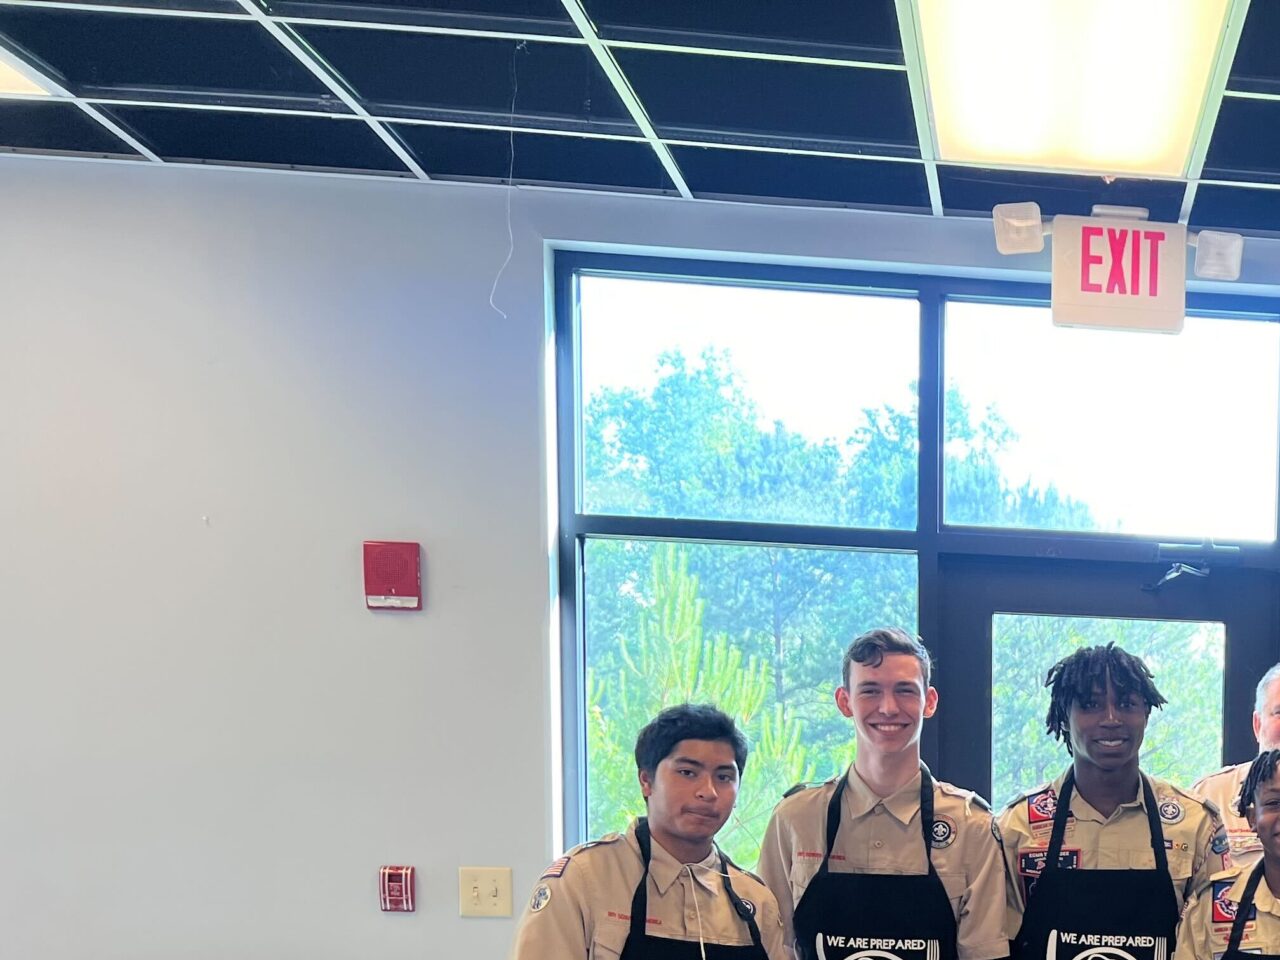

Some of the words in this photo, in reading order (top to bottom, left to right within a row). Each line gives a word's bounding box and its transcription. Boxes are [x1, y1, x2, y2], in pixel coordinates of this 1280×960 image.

[1081, 226, 1165, 297] EXIT
[826, 935, 846, 947] WE
[846, 937, 869, 949] ARE
[869, 938, 926, 950] PREPARED
[1060, 932, 1077, 944] WE
[1078, 934, 1100, 946] ARE
[1101, 935, 1155, 948] PREPARED
